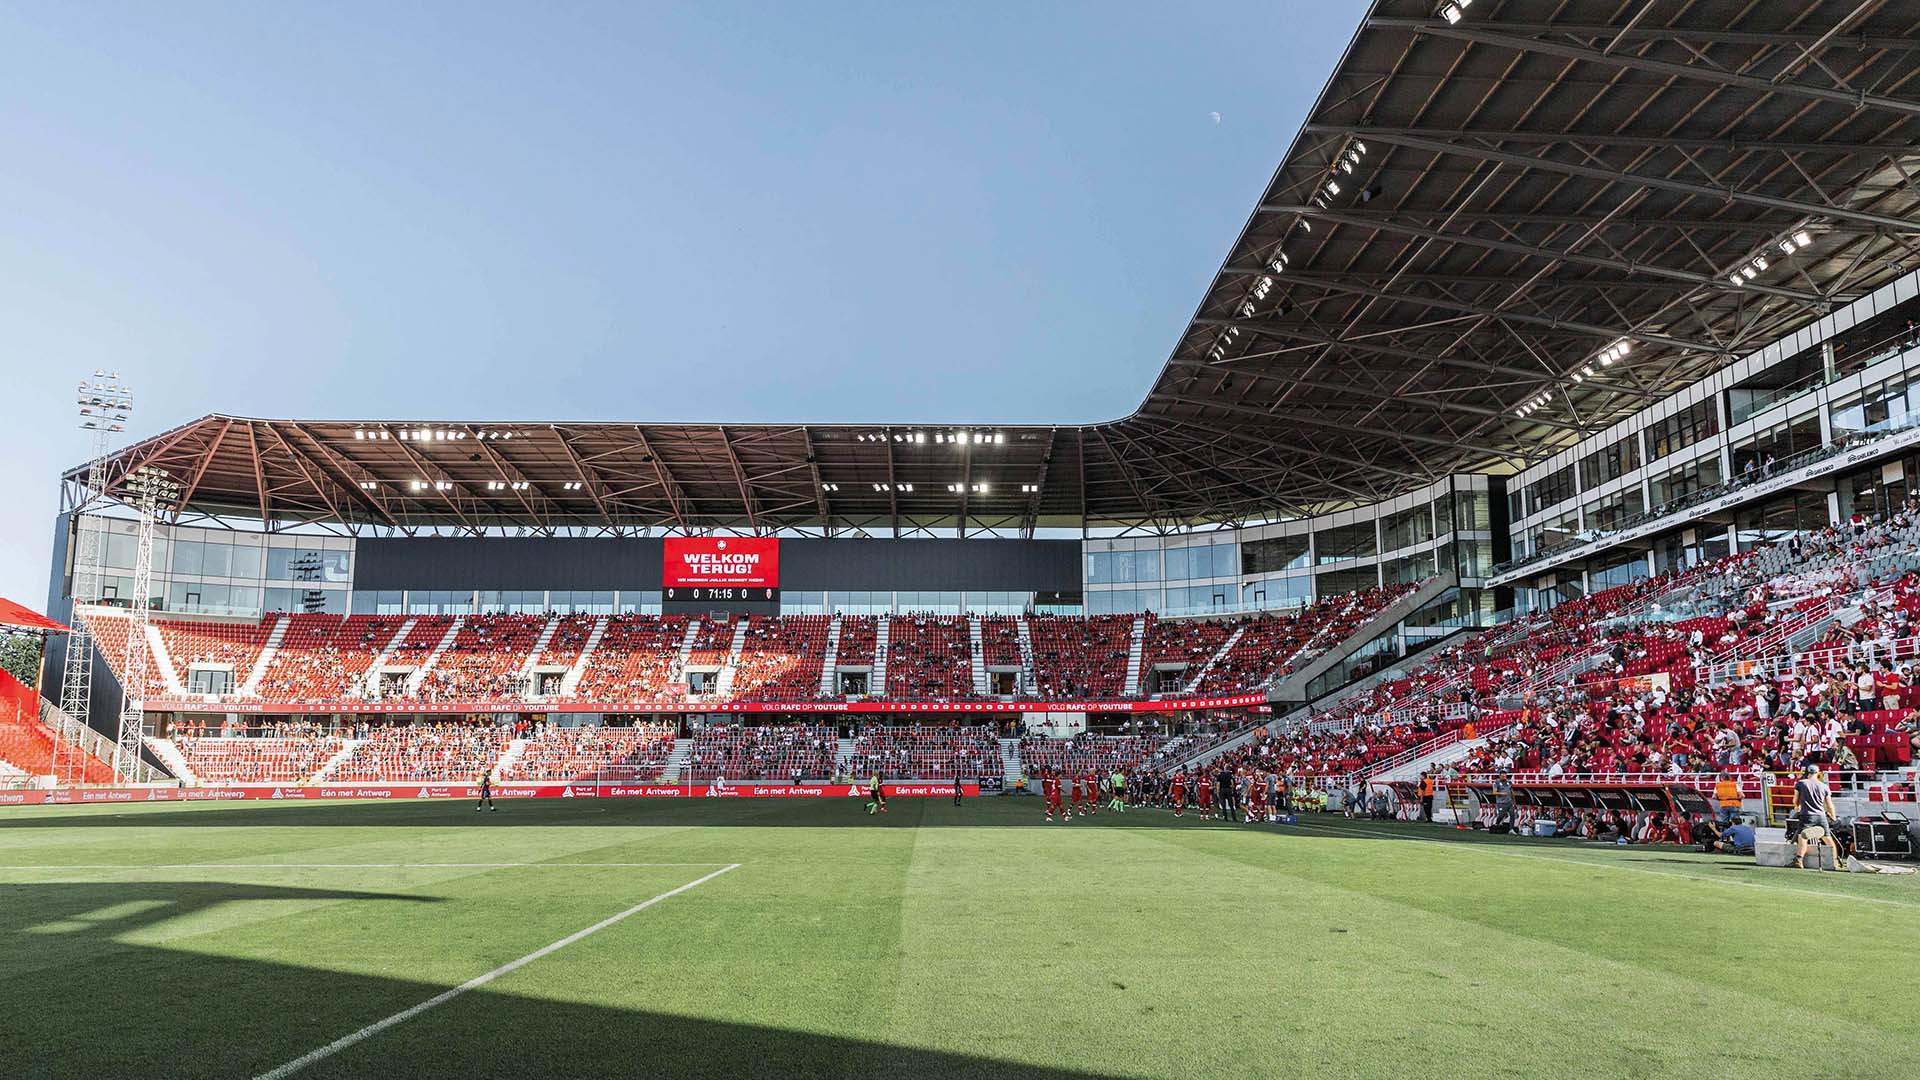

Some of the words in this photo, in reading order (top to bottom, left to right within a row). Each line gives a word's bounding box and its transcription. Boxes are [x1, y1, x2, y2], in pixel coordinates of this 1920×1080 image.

[684, 554, 760, 564] WELKOM
[690, 564, 752, 574] TERUG!
[693, 588, 699, 598] 0
[708, 588, 732, 598] 71:15
[741, 588, 747, 598] 0
[356, 789, 391, 798] Antwerp
[502, 788, 536, 797] Antwerp
[646, 788, 680, 796] Antwerp
